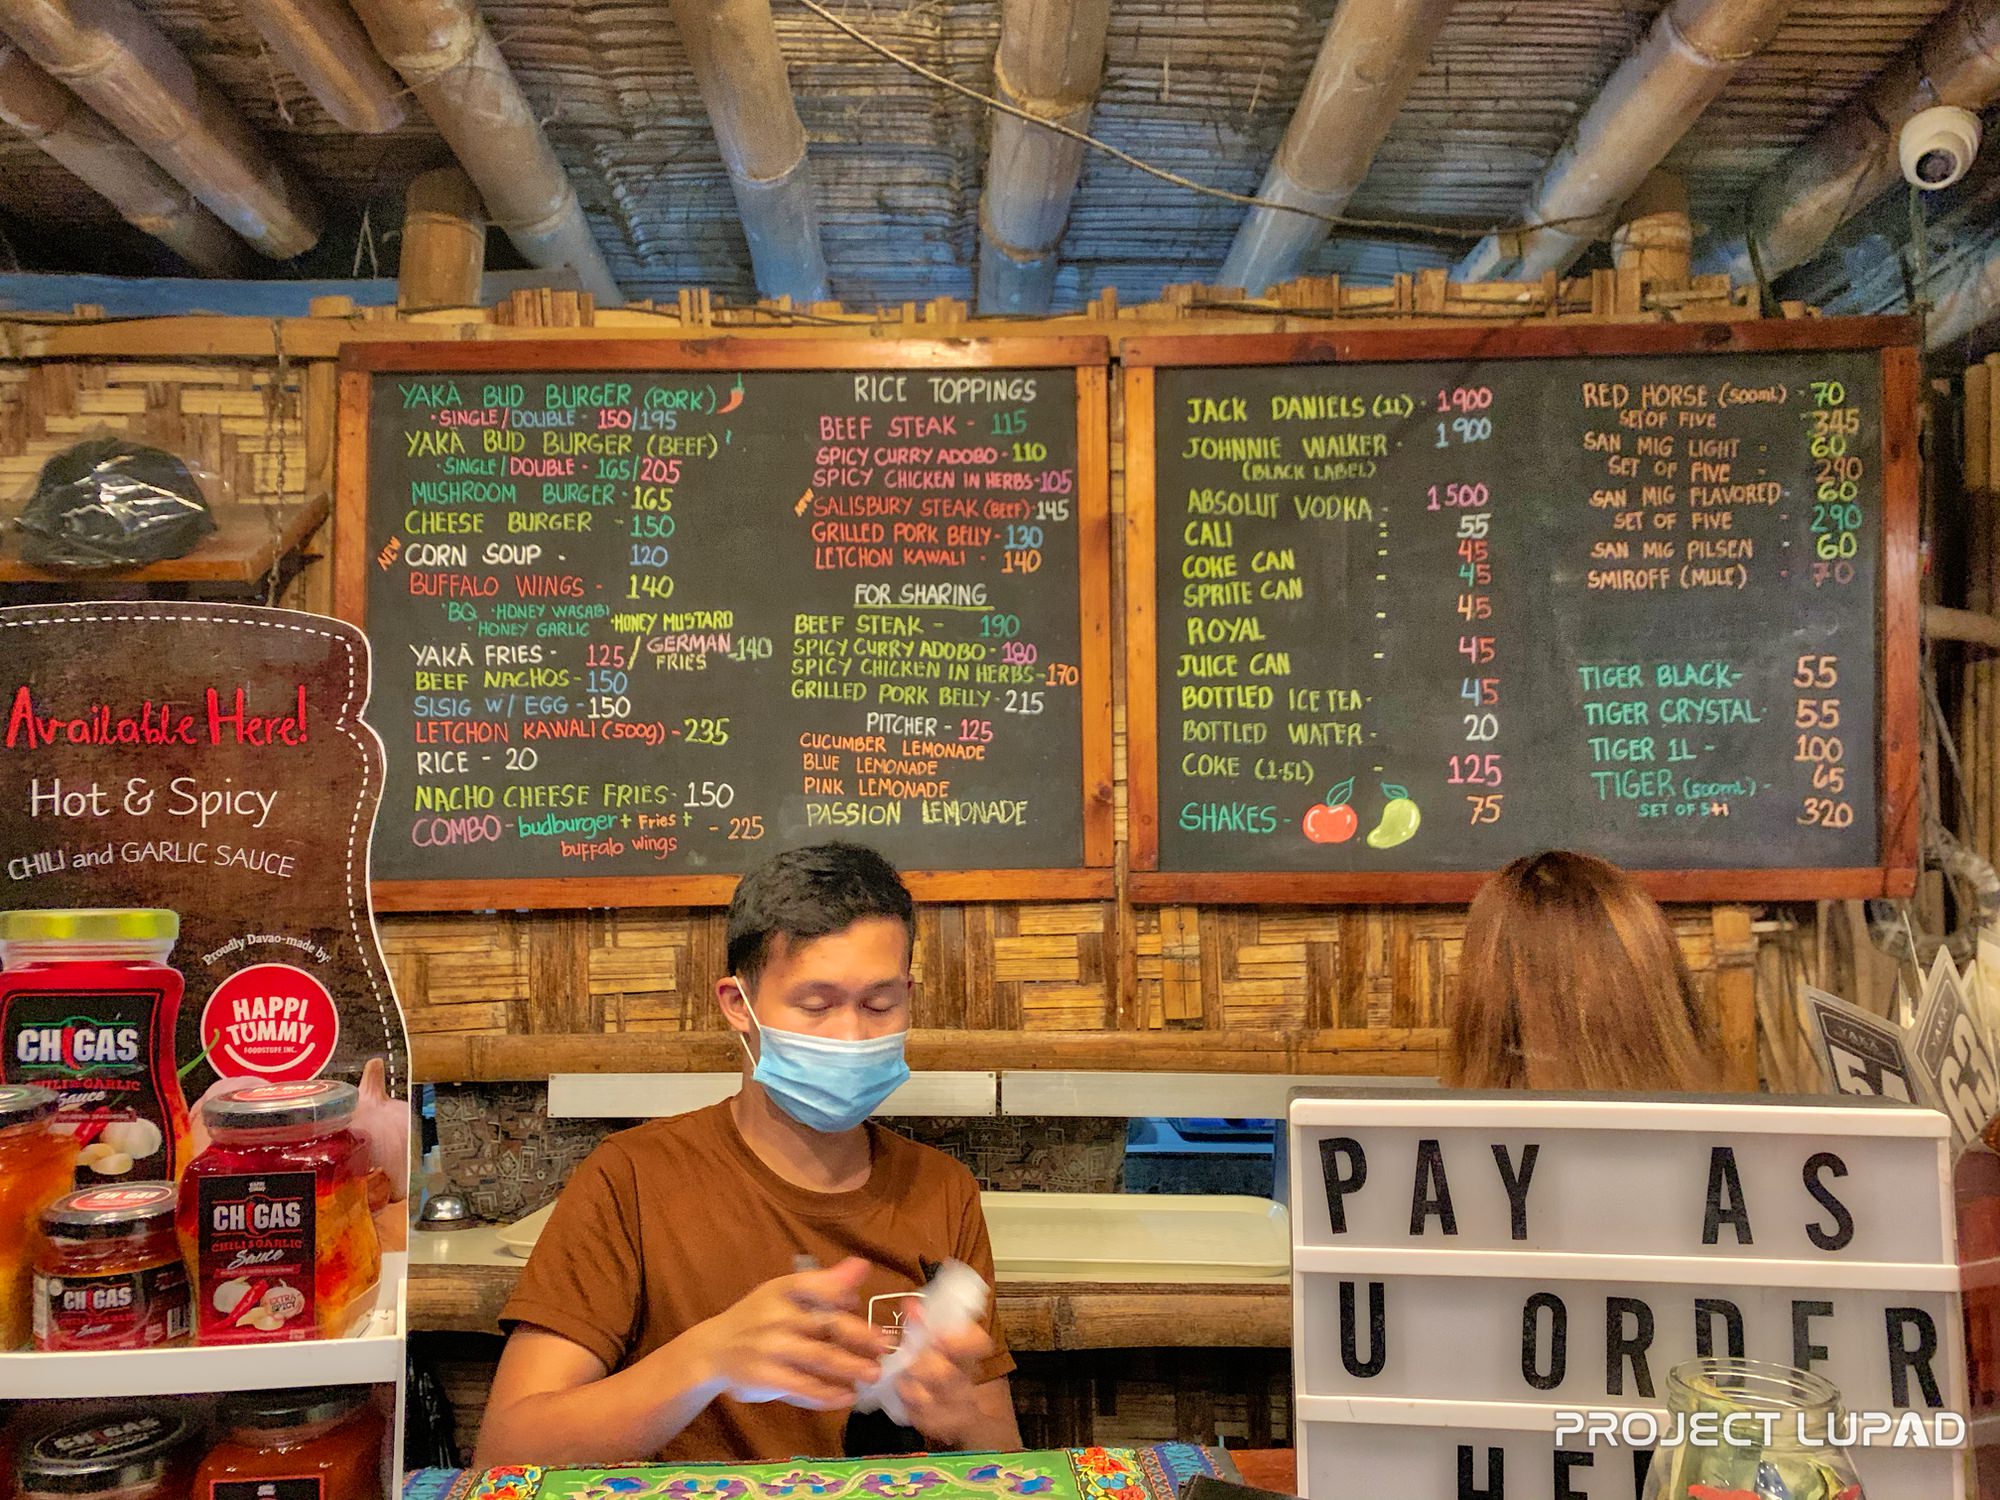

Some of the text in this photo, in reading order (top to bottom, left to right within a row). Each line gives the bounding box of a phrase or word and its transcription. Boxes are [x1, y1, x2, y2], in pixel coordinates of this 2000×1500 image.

[483, 385, 525, 407] BUD
[546, 384, 632, 407] BURGER
[854, 376, 1037, 404] RICE TOPPINGS
[1582, 382, 1708, 409] RED HORSE
[1187, 387, 1493, 424] JACK DANIELS 1900
[820, 409, 1028, 440] BEEF STEAK 115
[483, 430, 632, 456] BUD BURGER
[1012, 442, 1046, 462] 110
[1183, 417, 1492, 461] JOHNNIE WALKER 1900
[1584, 431, 1741, 458] SAN MIG LIGHT
[411, 481, 672, 512] MUSHROOM BURGER 165
[1188, 483, 1489, 522] ABSOLUT VODKA 1500
[1589, 482, 1782, 508] SAN MIG FLAVORED
[405, 510, 676, 538] CHEESE 150
[1184, 513, 1492, 547] CALI 55
[377, 535, 401, 571] NEW
[405, 543, 669, 567] CORN SOUP 120
[816, 547, 1042, 574] LETCHON KAWALI 140
[1591, 538, 1753, 560] SAN MIG PILSEN
[1183, 549, 1295, 579] COKE CAN
[409, 571, 674, 599] BUFFALO WINGS 140
[1184, 577, 1303, 607] SPRITE CAN
[1588, 569, 1670, 590] SMIROFF
[854, 583, 988, 606] FOR SHARING
[536, 621, 590, 637] GARLIC
[662, 610, 734, 630] MUSTARD
[794, 614, 1020, 638] BEEF STEAK 190
[1186, 595, 1492, 645] ROYAL 45
[485, 633, 731, 665] FRIES GERMAN
[656, 653, 706, 671] FRIES
[792, 638, 986, 662] SPICY CURRY ADOBO
[860, 660, 1034, 684] CHICKEN IN HERBS
[1177, 652, 1291, 678] JUICE CAN
[1578, 654, 1837, 690] TIGER BLACK 55
[483, 667, 628, 694] NACHOS 150
[412, 697, 569, 718] SISIG EGG
[792, 680, 1044, 714] GRILLED PORK BELLY 215
[1181, 685, 1274, 711] BOTTLED
[6, 685, 308, 750] Available Here!
[1584, 697, 1761, 726] TIGER CRYSTAL
[415, 721, 509, 744] LETCHON
[523, 719, 596, 741] KAWALI
[684, 718, 731, 746] 235
[866, 712, 994, 743] PITCHER 125
[1183, 713, 1499, 747] BOTTLED WATER 20
[800, 732, 986, 760] CUCUMBER LEMONADE
[1794, 734, 1843, 763] 100
[417, 747, 538, 775] RICE 20
[803, 752, 938, 776] BLUE LEMONADE
[1181, 753, 1503, 788] COKE 125
[414, 784, 589, 812] NACHO CHEESE
[804, 776, 844, 796] PINK
[30, 777, 278, 828] Hot & Spicy
[806, 801, 901, 828] PASSION
[1179, 794, 1504, 834] SHAKES 75
[1797, 797, 1854, 828] 320
[412, 814, 501, 847] COMBO
[517, 814, 618, 839] budburger
[727, 815, 765, 841] 225
[7, 841, 295, 881] CHILI and GARLIC SAUCE
[560, 835, 678, 860] buffalo wings
[202, 938, 245, 966] Proudly
[246, 934, 315, 953] Davao-made
[232, 996, 308, 1022] HAPPI
[226, 1020, 314, 1046] TUMMY
[1318, 1136, 1855, 1252] PAY AS
[1338, 1281, 1387, 1379] U
